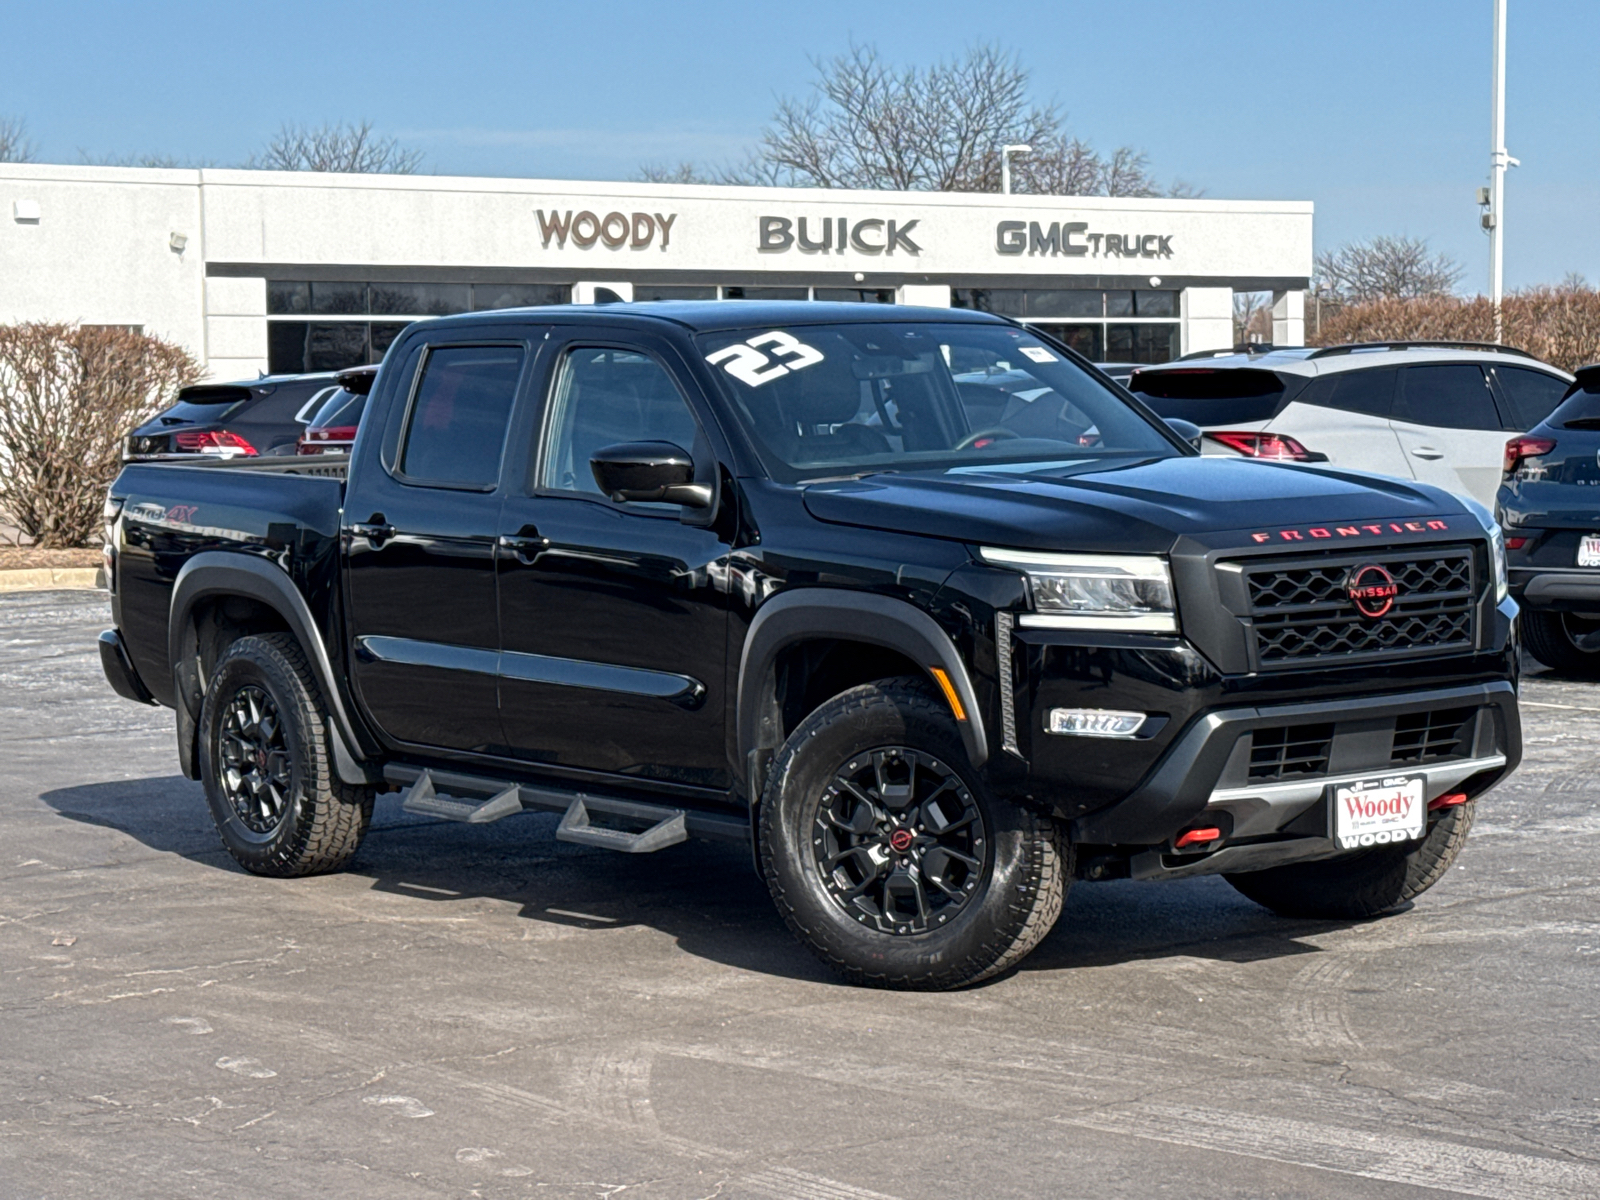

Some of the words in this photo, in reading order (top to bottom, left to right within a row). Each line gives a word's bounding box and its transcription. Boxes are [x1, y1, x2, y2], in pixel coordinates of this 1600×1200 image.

[533, 209, 678, 251] WOODY
[757, 215, 924, 256] BUICK
[996, 220, 1089, 257] GMC
[1085, 233, 1174, 259] TRUCK
[705, 331, 825, 388] 23
[1251, 520, 1449, 543] FRONTIER
[1350, 583, 1398, 599] NISSAN
[1344, 791, 1415, 820] Woody
[1340, 827, 1422, 850] WOODY
